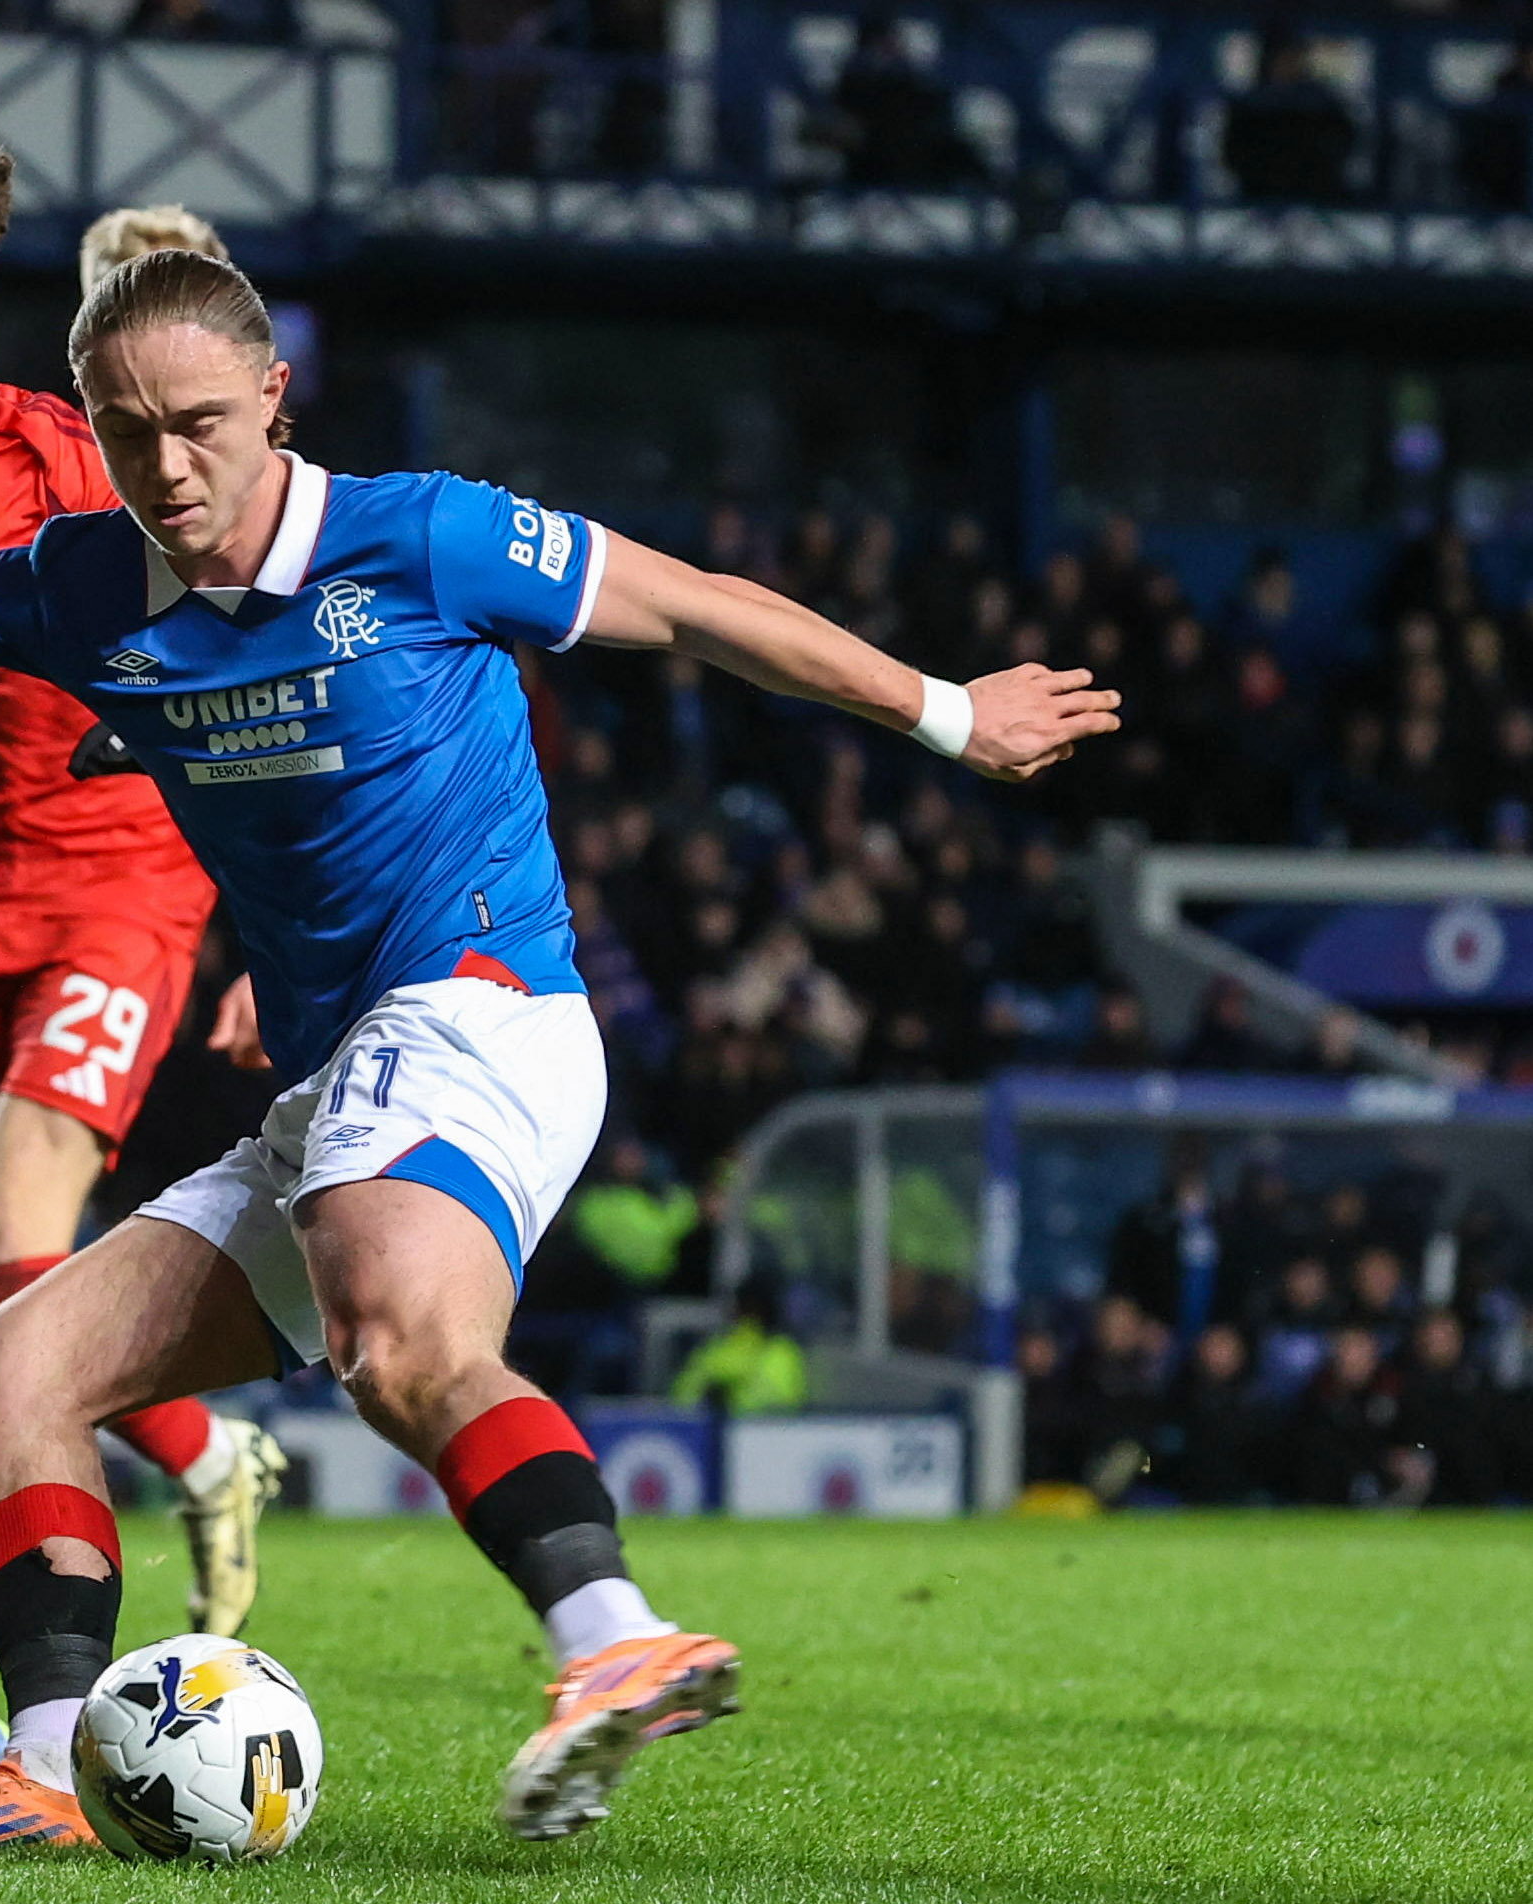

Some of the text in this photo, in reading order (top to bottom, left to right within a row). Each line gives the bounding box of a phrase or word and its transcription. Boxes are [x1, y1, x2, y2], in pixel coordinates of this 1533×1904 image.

[117, 674, 159, 687] umbro
[163, 665, 336, 729] UNIBET
[206, 754, 320, 780] ZERO% MISSION
[41, 973, 150, 1075] 29
